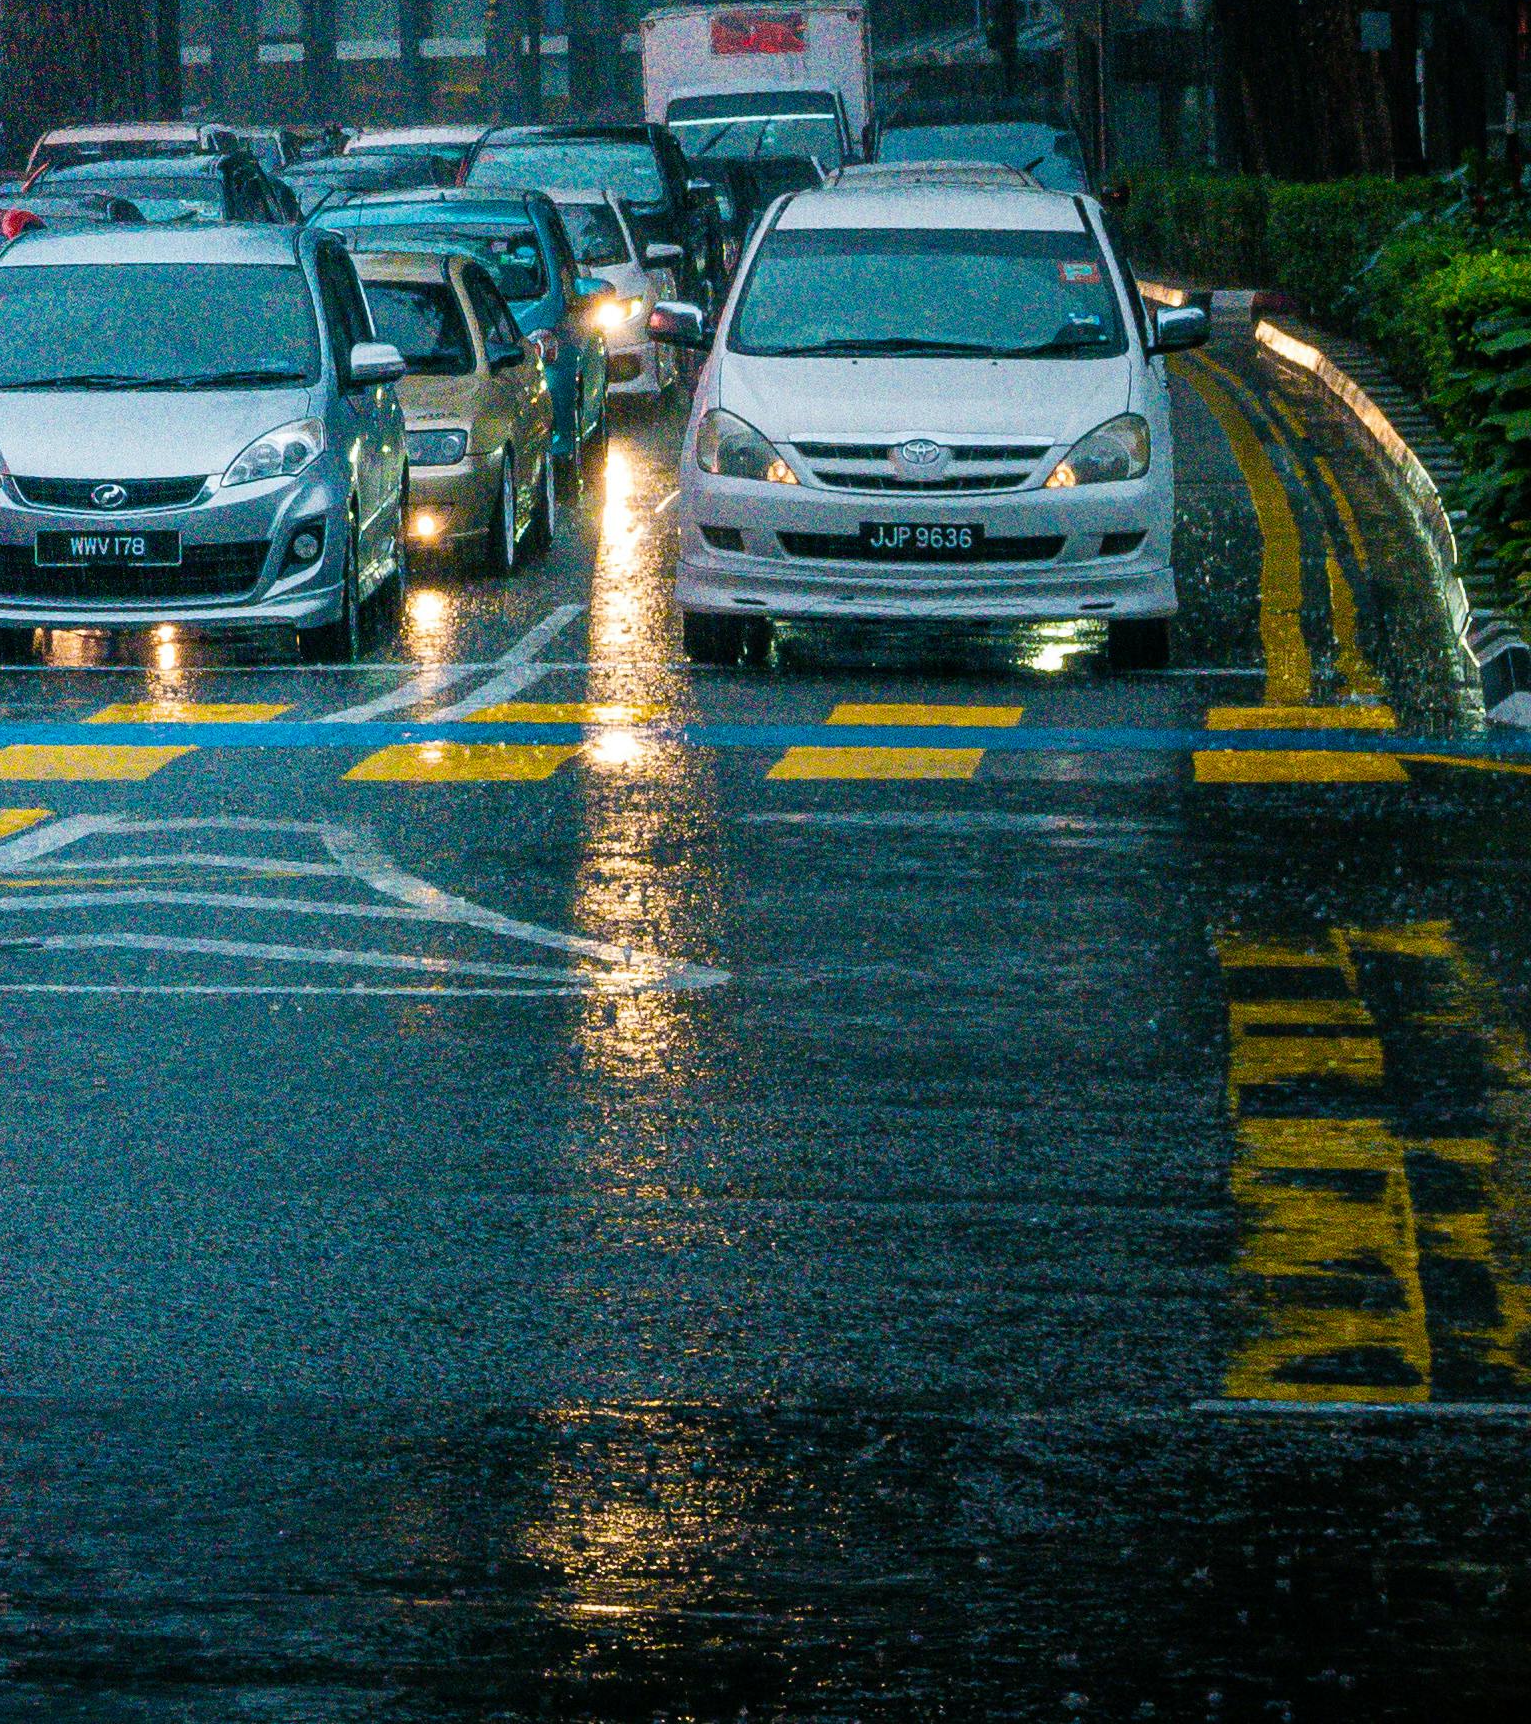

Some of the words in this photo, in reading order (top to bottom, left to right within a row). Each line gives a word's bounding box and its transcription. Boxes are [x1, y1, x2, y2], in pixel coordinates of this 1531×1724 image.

[70, 537, 109, 555] WWV
[114, 537, 145, 555] 178
[870, 526, 911, 548] JJP
[915, 526, 972, 549] 9636
